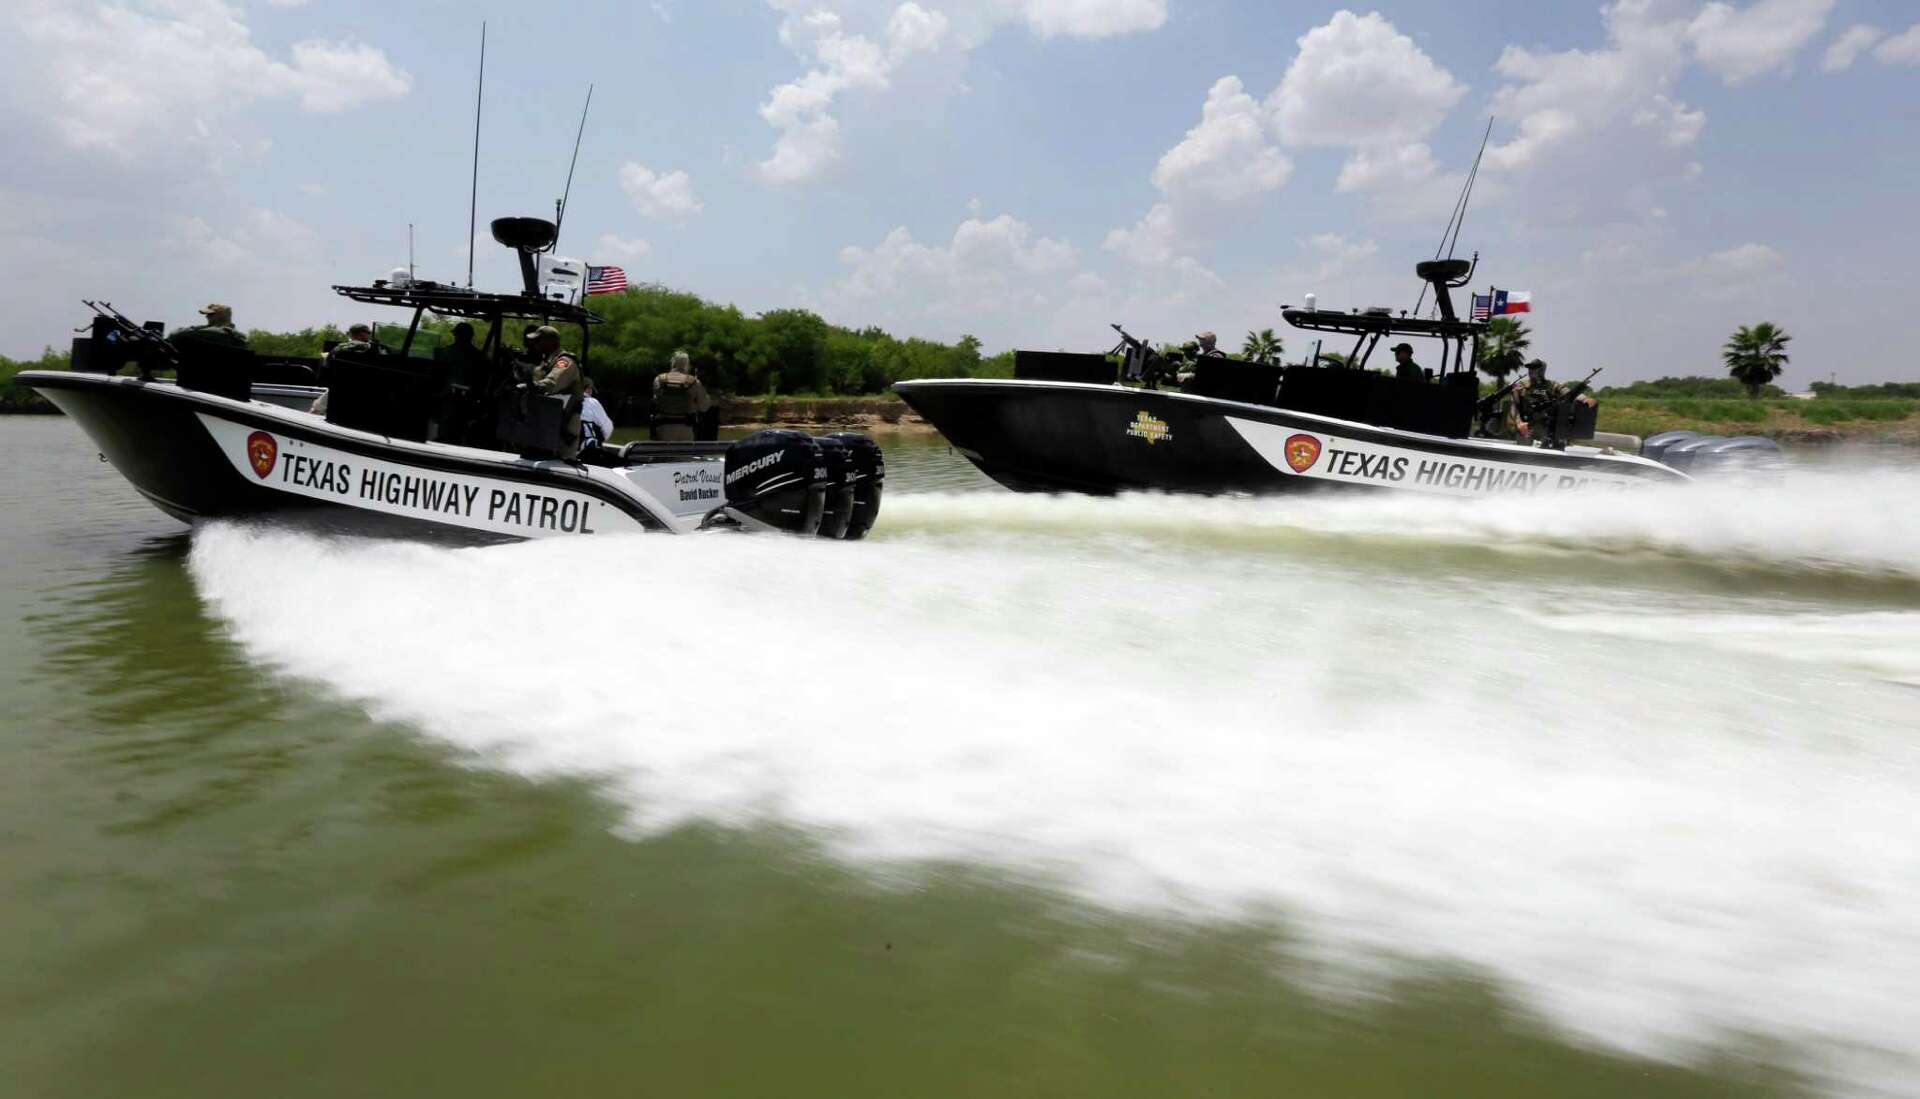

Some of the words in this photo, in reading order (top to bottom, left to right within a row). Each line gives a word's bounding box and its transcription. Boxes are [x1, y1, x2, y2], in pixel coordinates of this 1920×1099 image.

[673, 470, 698, 488] Patrol
[699, 468, 722, 484] Vessel
[726, 449, 785, 486] MERCURY
[1326, 448, 1409, 482] TEXAS
[1414, 459, 1549, 495] HIGHWAY
[281, 452, 351, 495] TEXAS
[360, 468, 480, 518] HIGHWAY
[487, 489, 595, 535] PATROL
[679, 488, 698, 501] David
